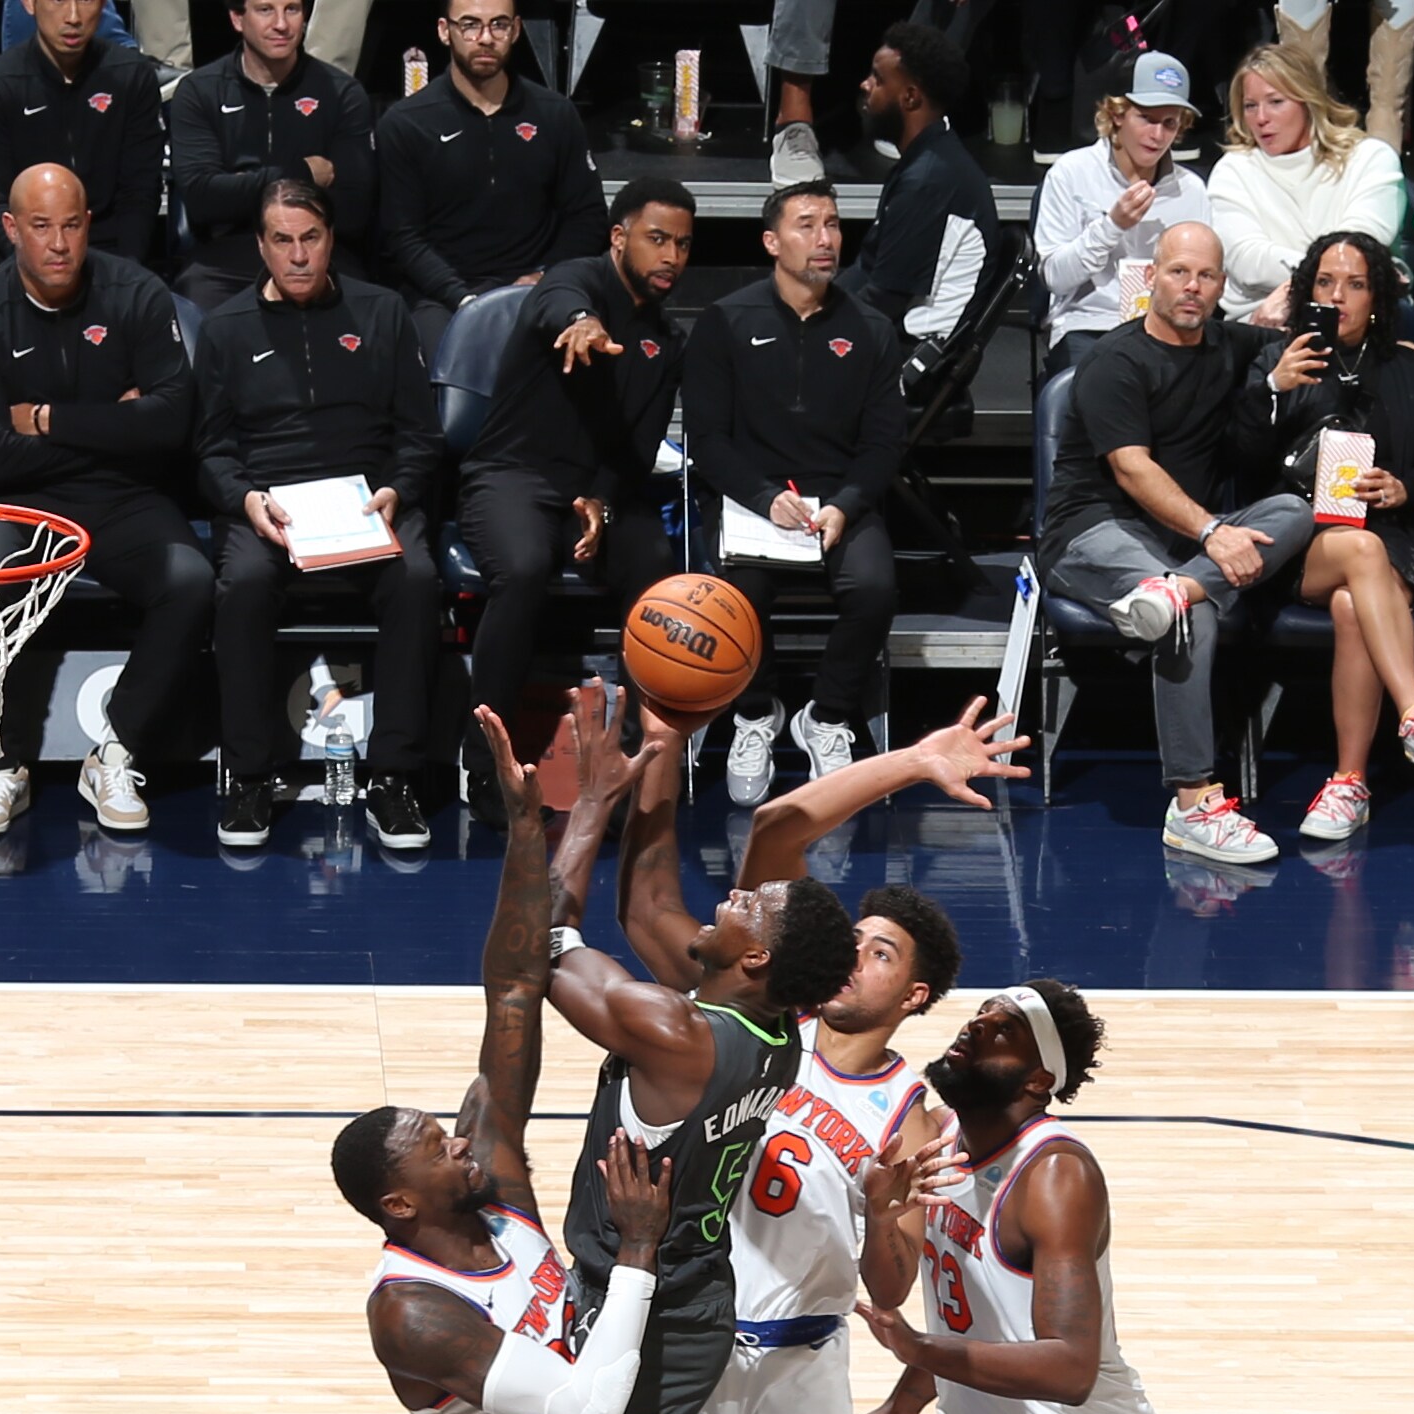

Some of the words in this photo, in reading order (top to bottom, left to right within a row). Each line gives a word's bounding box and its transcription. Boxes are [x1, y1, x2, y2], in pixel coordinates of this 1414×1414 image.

[639, 604, 718, 662] Wilson
[749, 1130, 814, 1218] 6
[801, 1095, 876, 1177] YORK
